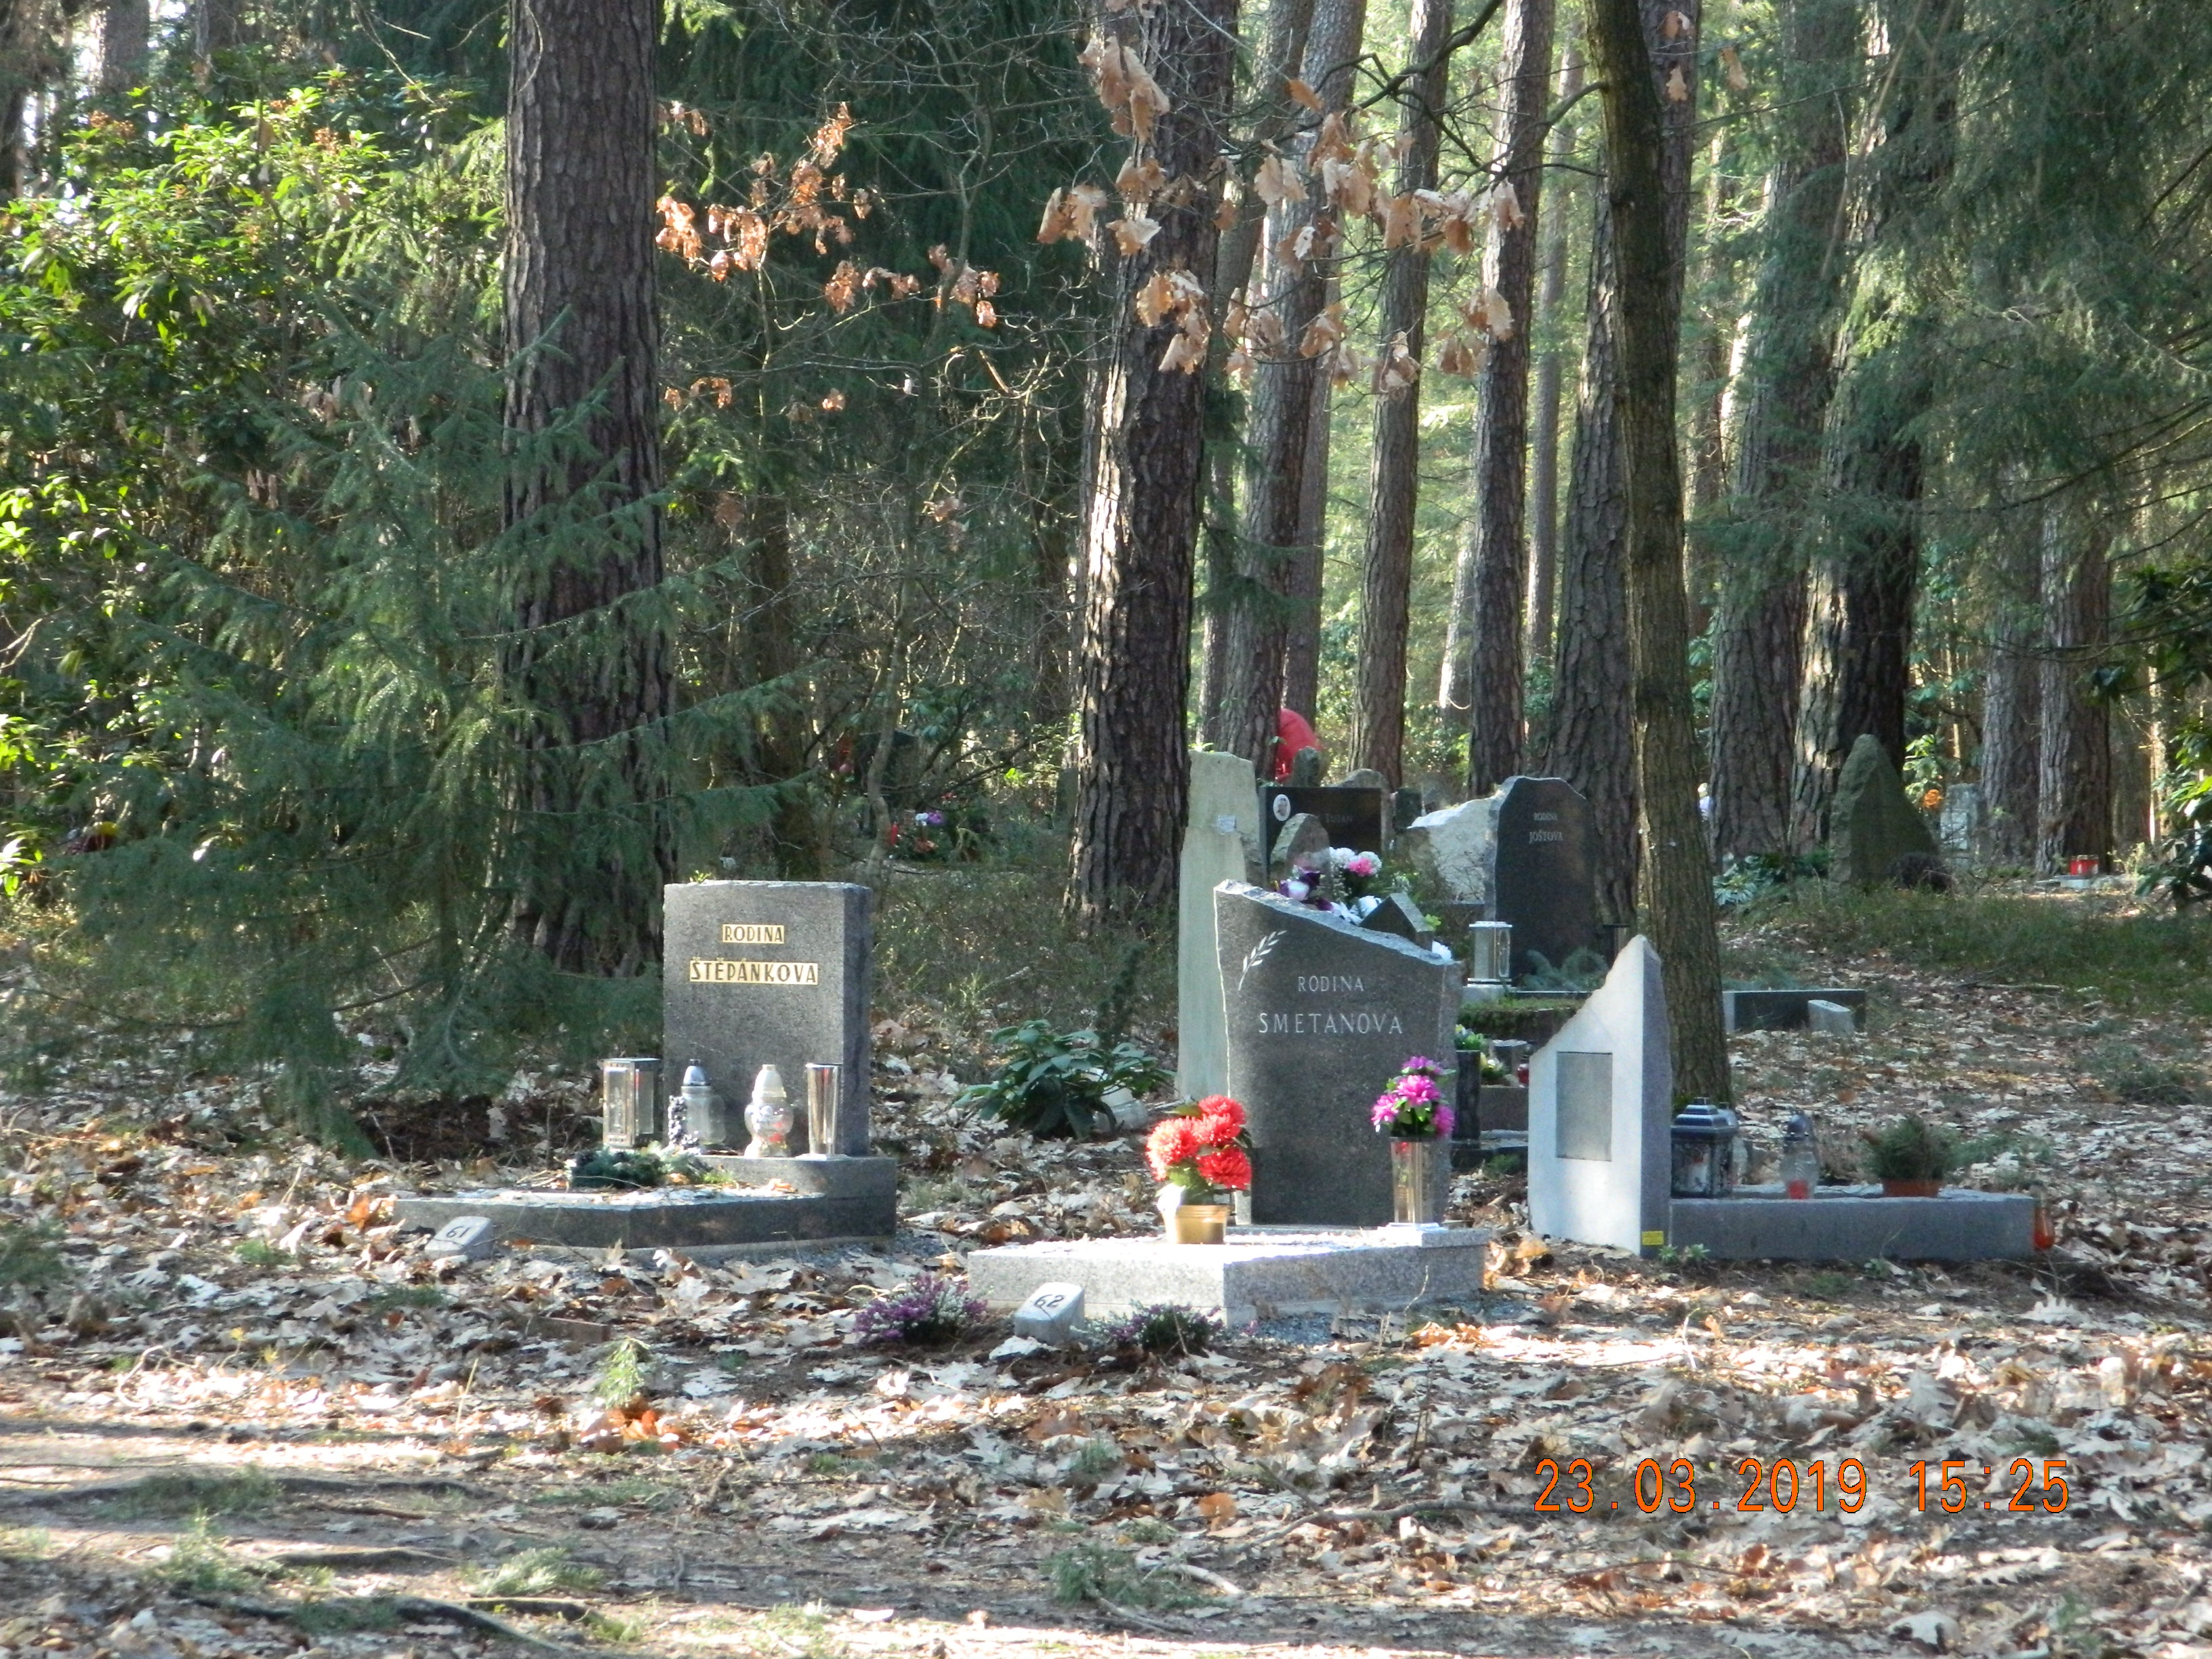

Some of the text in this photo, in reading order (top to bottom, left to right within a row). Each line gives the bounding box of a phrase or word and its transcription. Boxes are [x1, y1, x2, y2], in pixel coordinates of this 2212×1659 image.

[724, 926, 783, 942] RODINA
[690, 957, 817, 983] ŠTĚPÁNKOVA
[1298, 975, 1364, 991] RODINA
[1258, 1012, 1403, 1034] SMETANOVA
[446, 1226, 472, 1238] 61
[1033, 1294, 1065, 1308] 62
